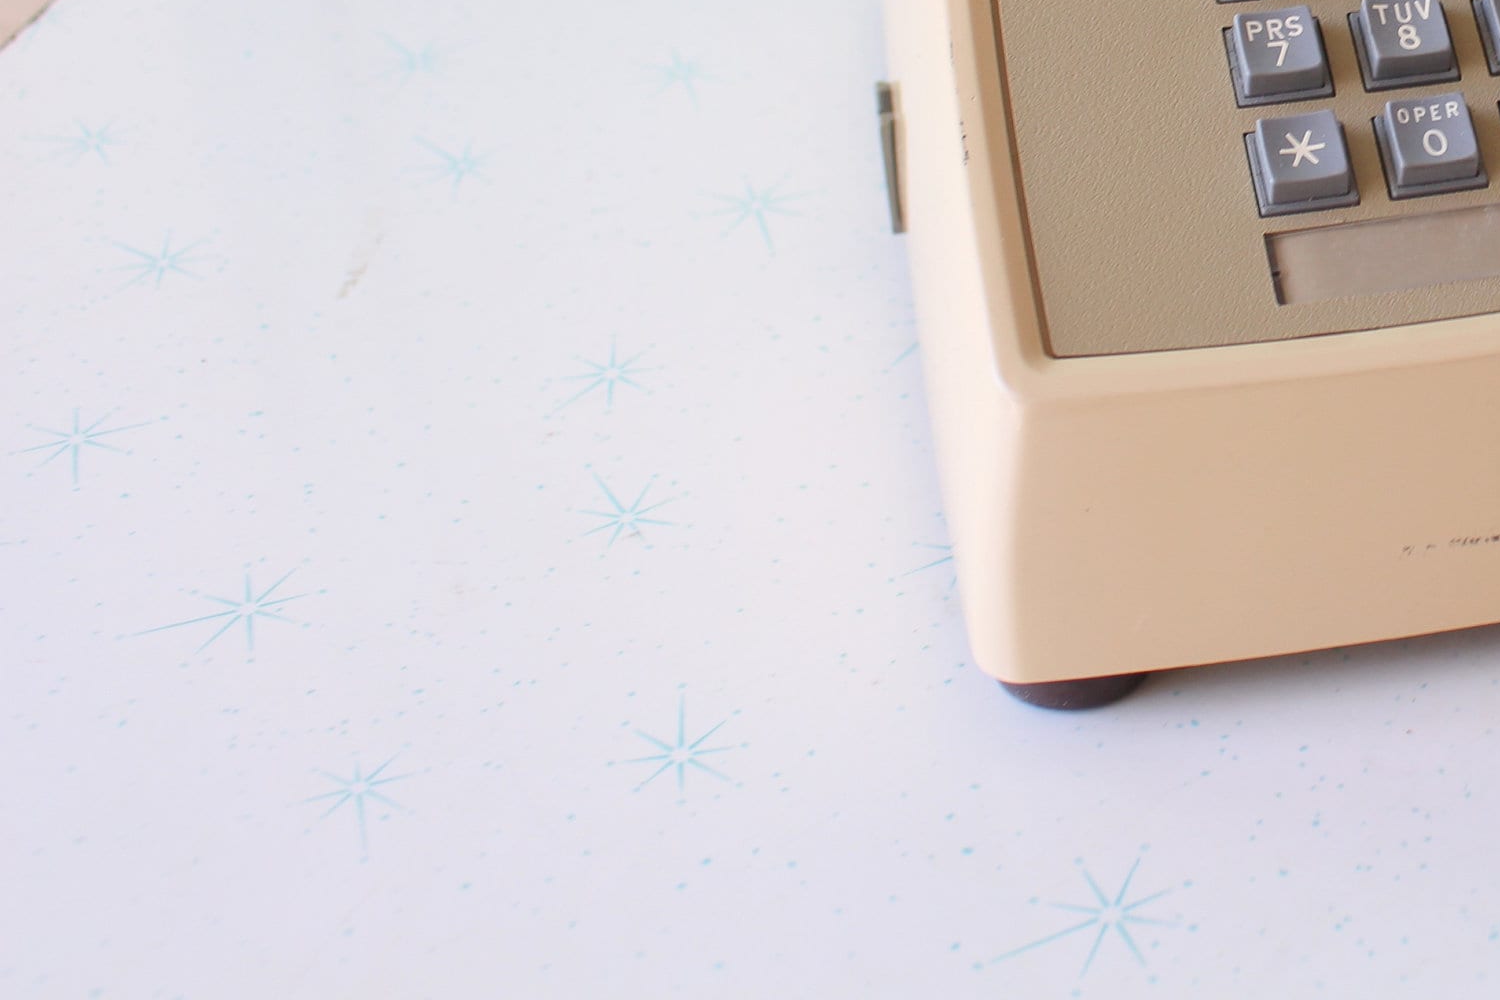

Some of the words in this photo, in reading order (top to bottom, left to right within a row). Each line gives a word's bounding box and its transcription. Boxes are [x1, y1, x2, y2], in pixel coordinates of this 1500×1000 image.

[1245, 15, 1304, 42] PRS
[1397, 24, 1422, 51] 8
[1267, 40, 1290, 67] 7
[1396, 100, 1460, 125] OPER
